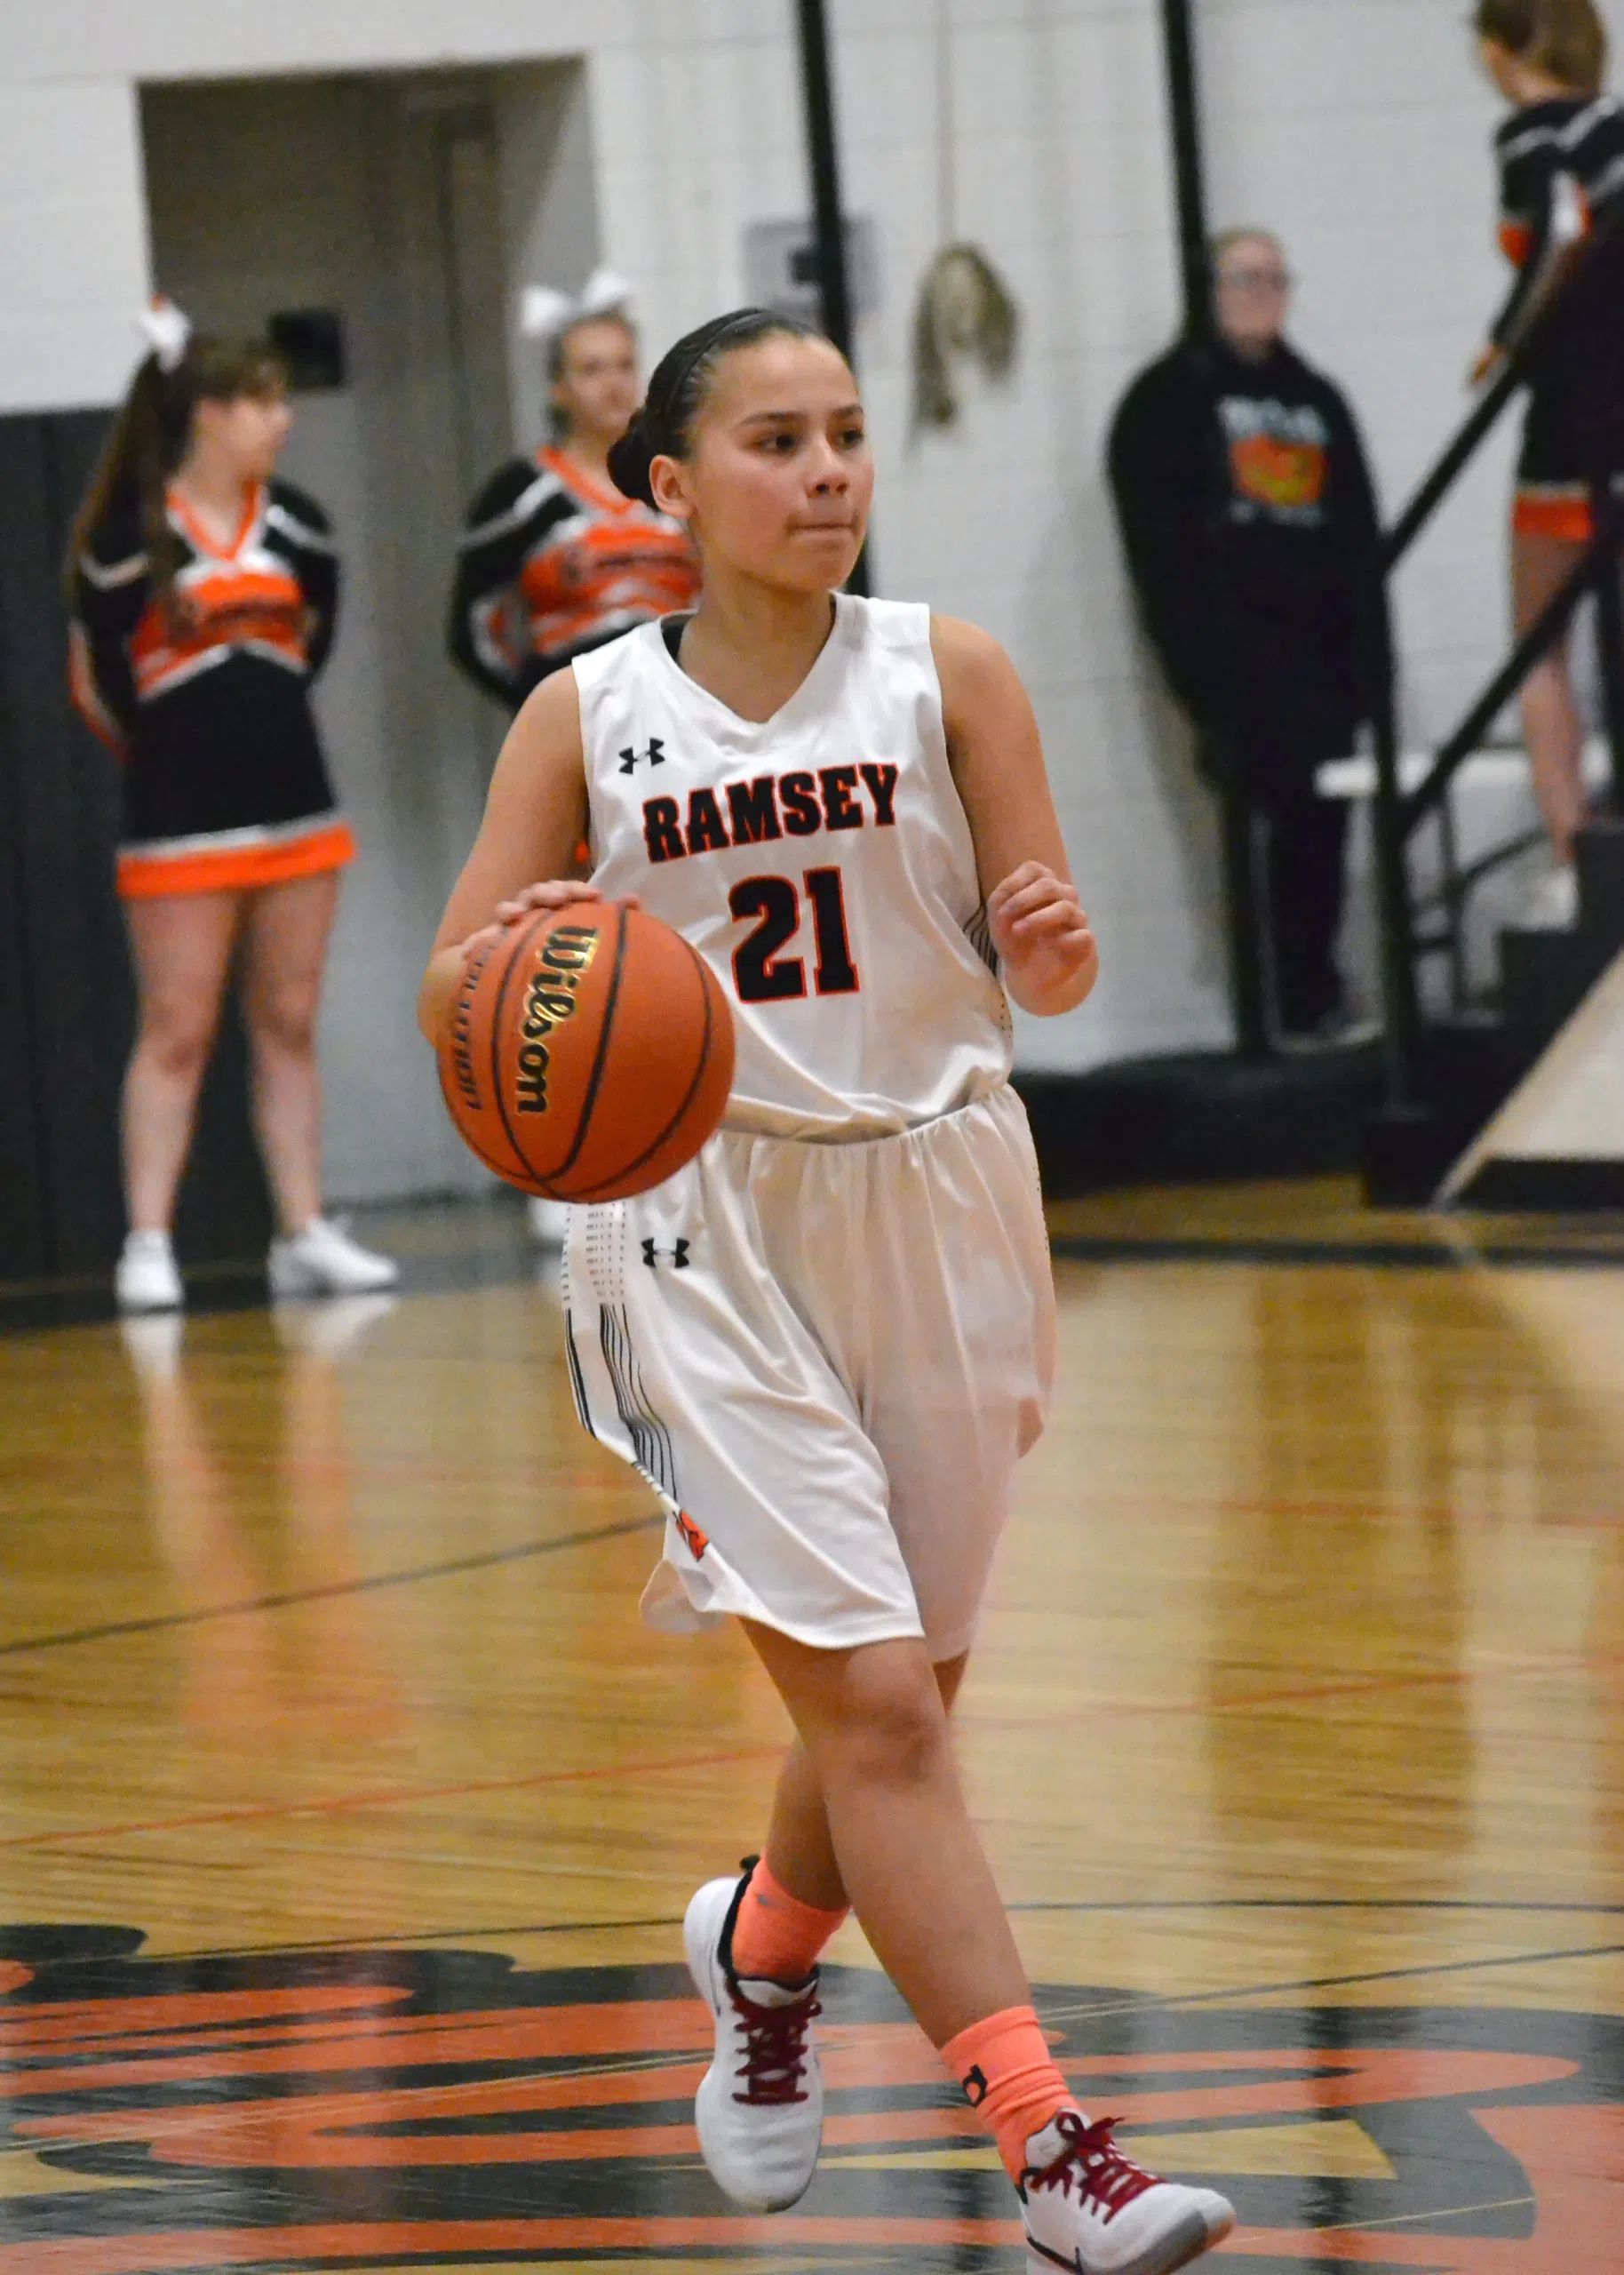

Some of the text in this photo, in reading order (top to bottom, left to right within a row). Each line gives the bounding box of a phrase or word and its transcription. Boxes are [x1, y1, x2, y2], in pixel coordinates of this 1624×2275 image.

[641, 762, 899, 864] RAMSEY
[728, 866, 859, 1004] 21
[515, 925, 599, 1116] Wilson
